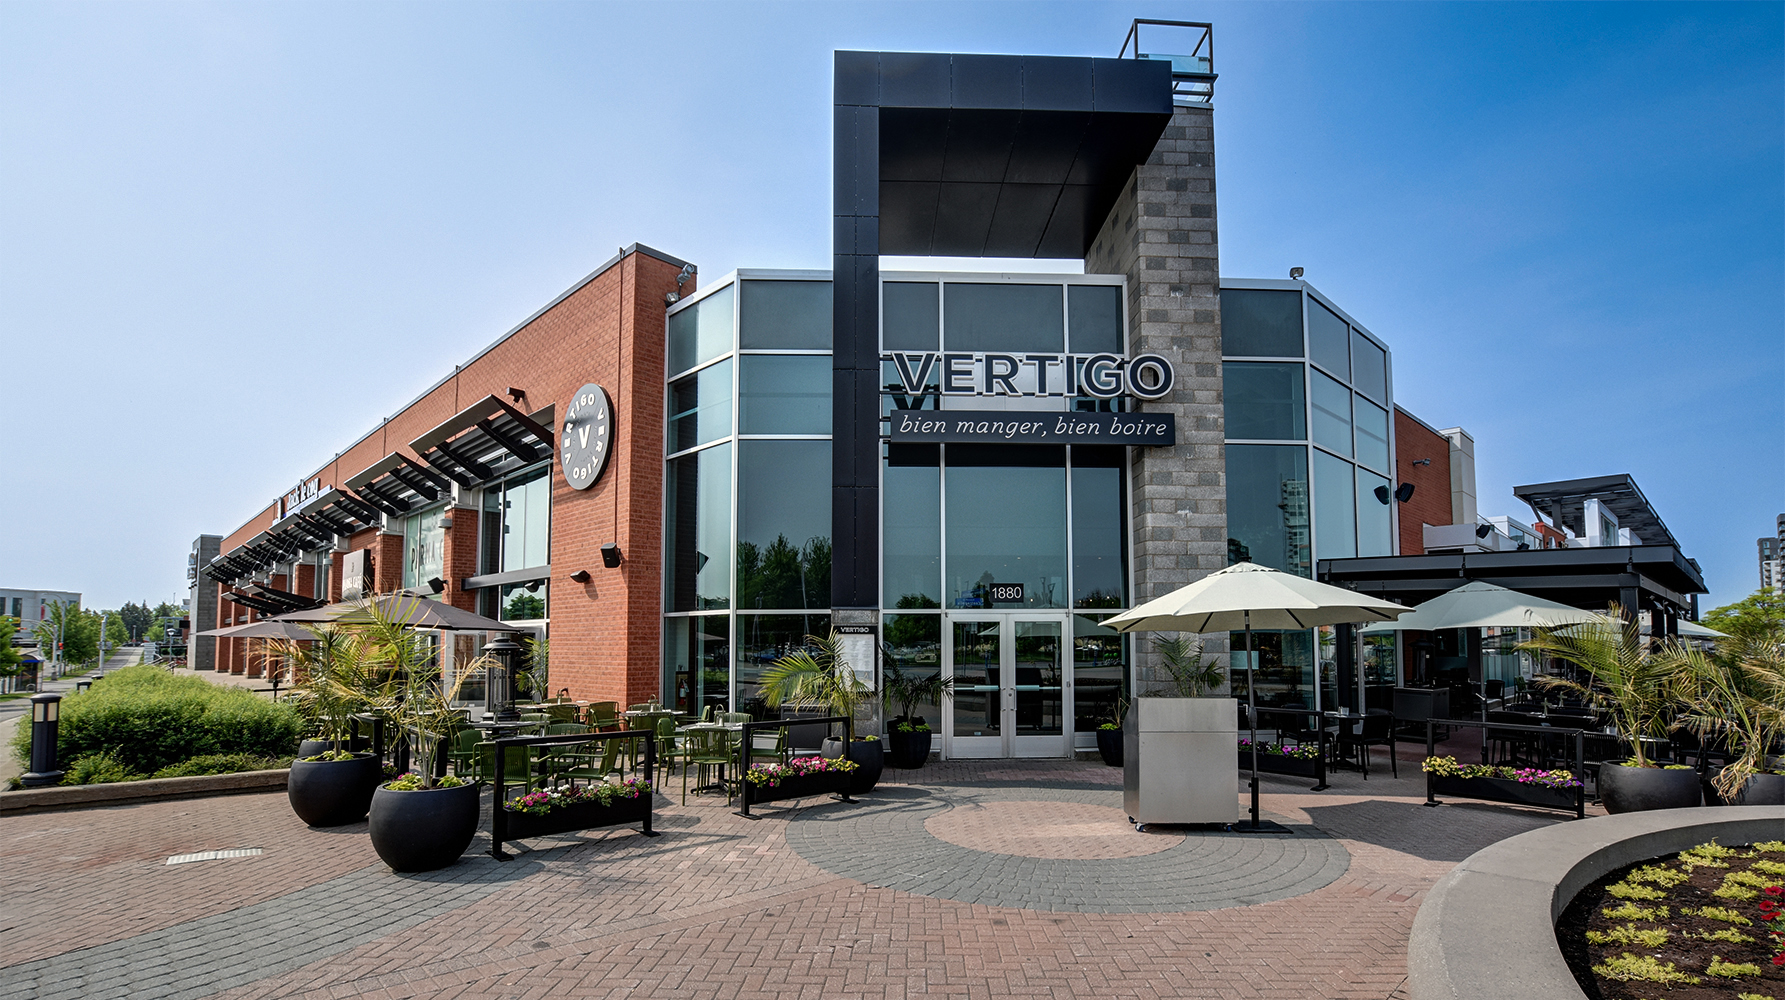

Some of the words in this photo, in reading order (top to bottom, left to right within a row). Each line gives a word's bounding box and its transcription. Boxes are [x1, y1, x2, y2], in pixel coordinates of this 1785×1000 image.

[891, 352, 1175, 399] VERTIGO
[579, 424, 591, 449] V
[900, 414, 946, 433] bien
[956, 420, 1047, 438] manger,
[1055, 416, 1100, 434] bien
[1109, 417, 1167, 435] boire
[992, 586, 1022, 599] 1880
